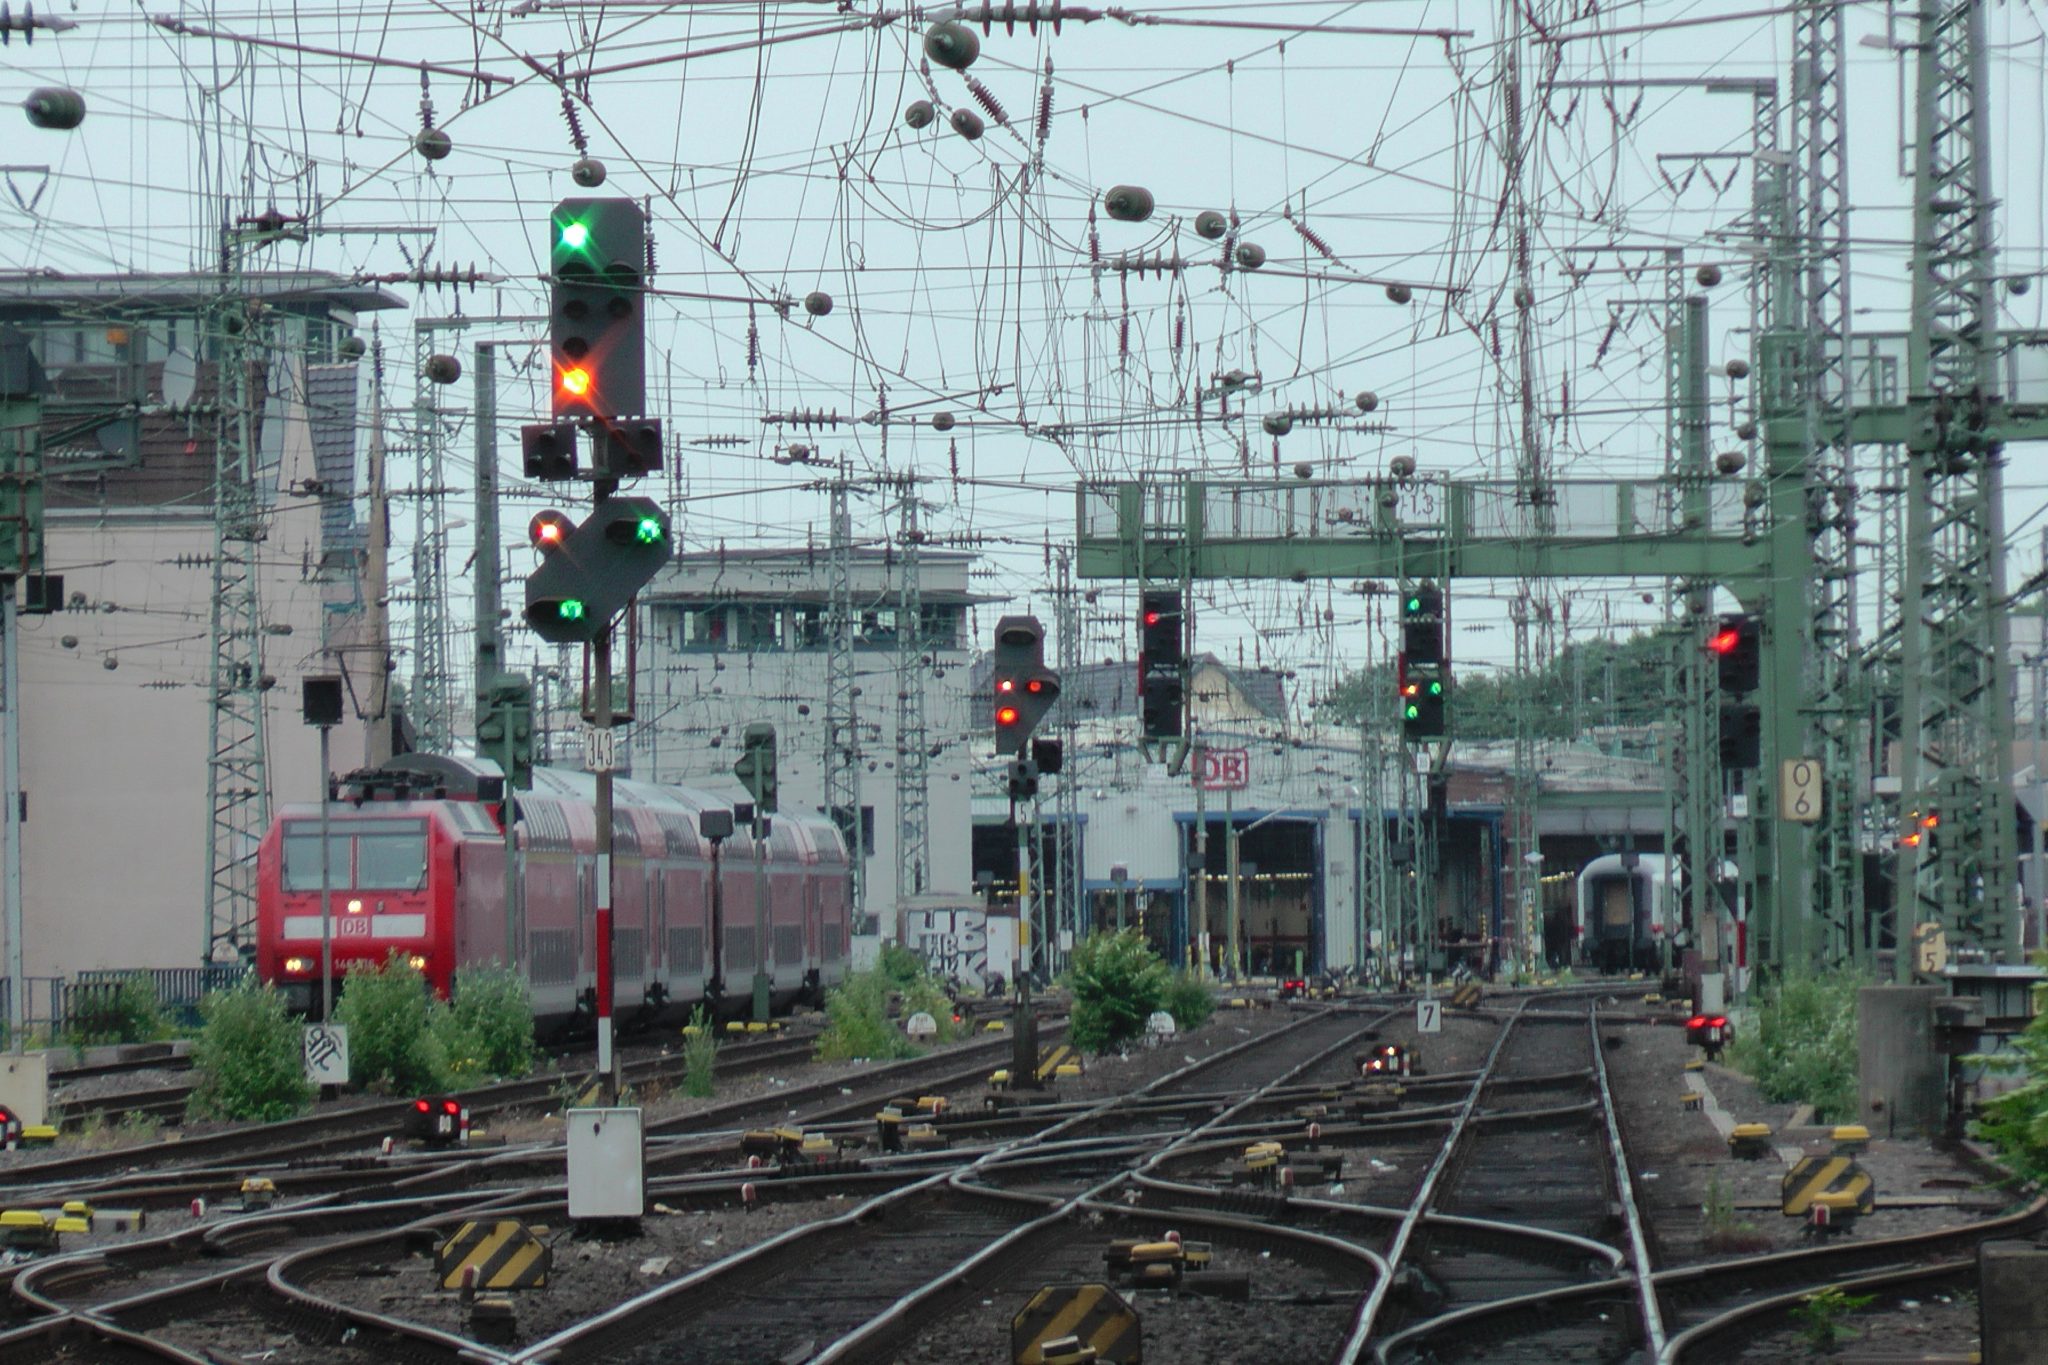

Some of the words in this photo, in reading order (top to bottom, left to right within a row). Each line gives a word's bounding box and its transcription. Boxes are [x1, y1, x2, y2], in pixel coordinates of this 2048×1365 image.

[588, 732, 612, 766] 343
[1200, 752, 1243, 783] DB
[343, 919, 366, 934] DB
[1424, 1006, 1434, 1028] 7
